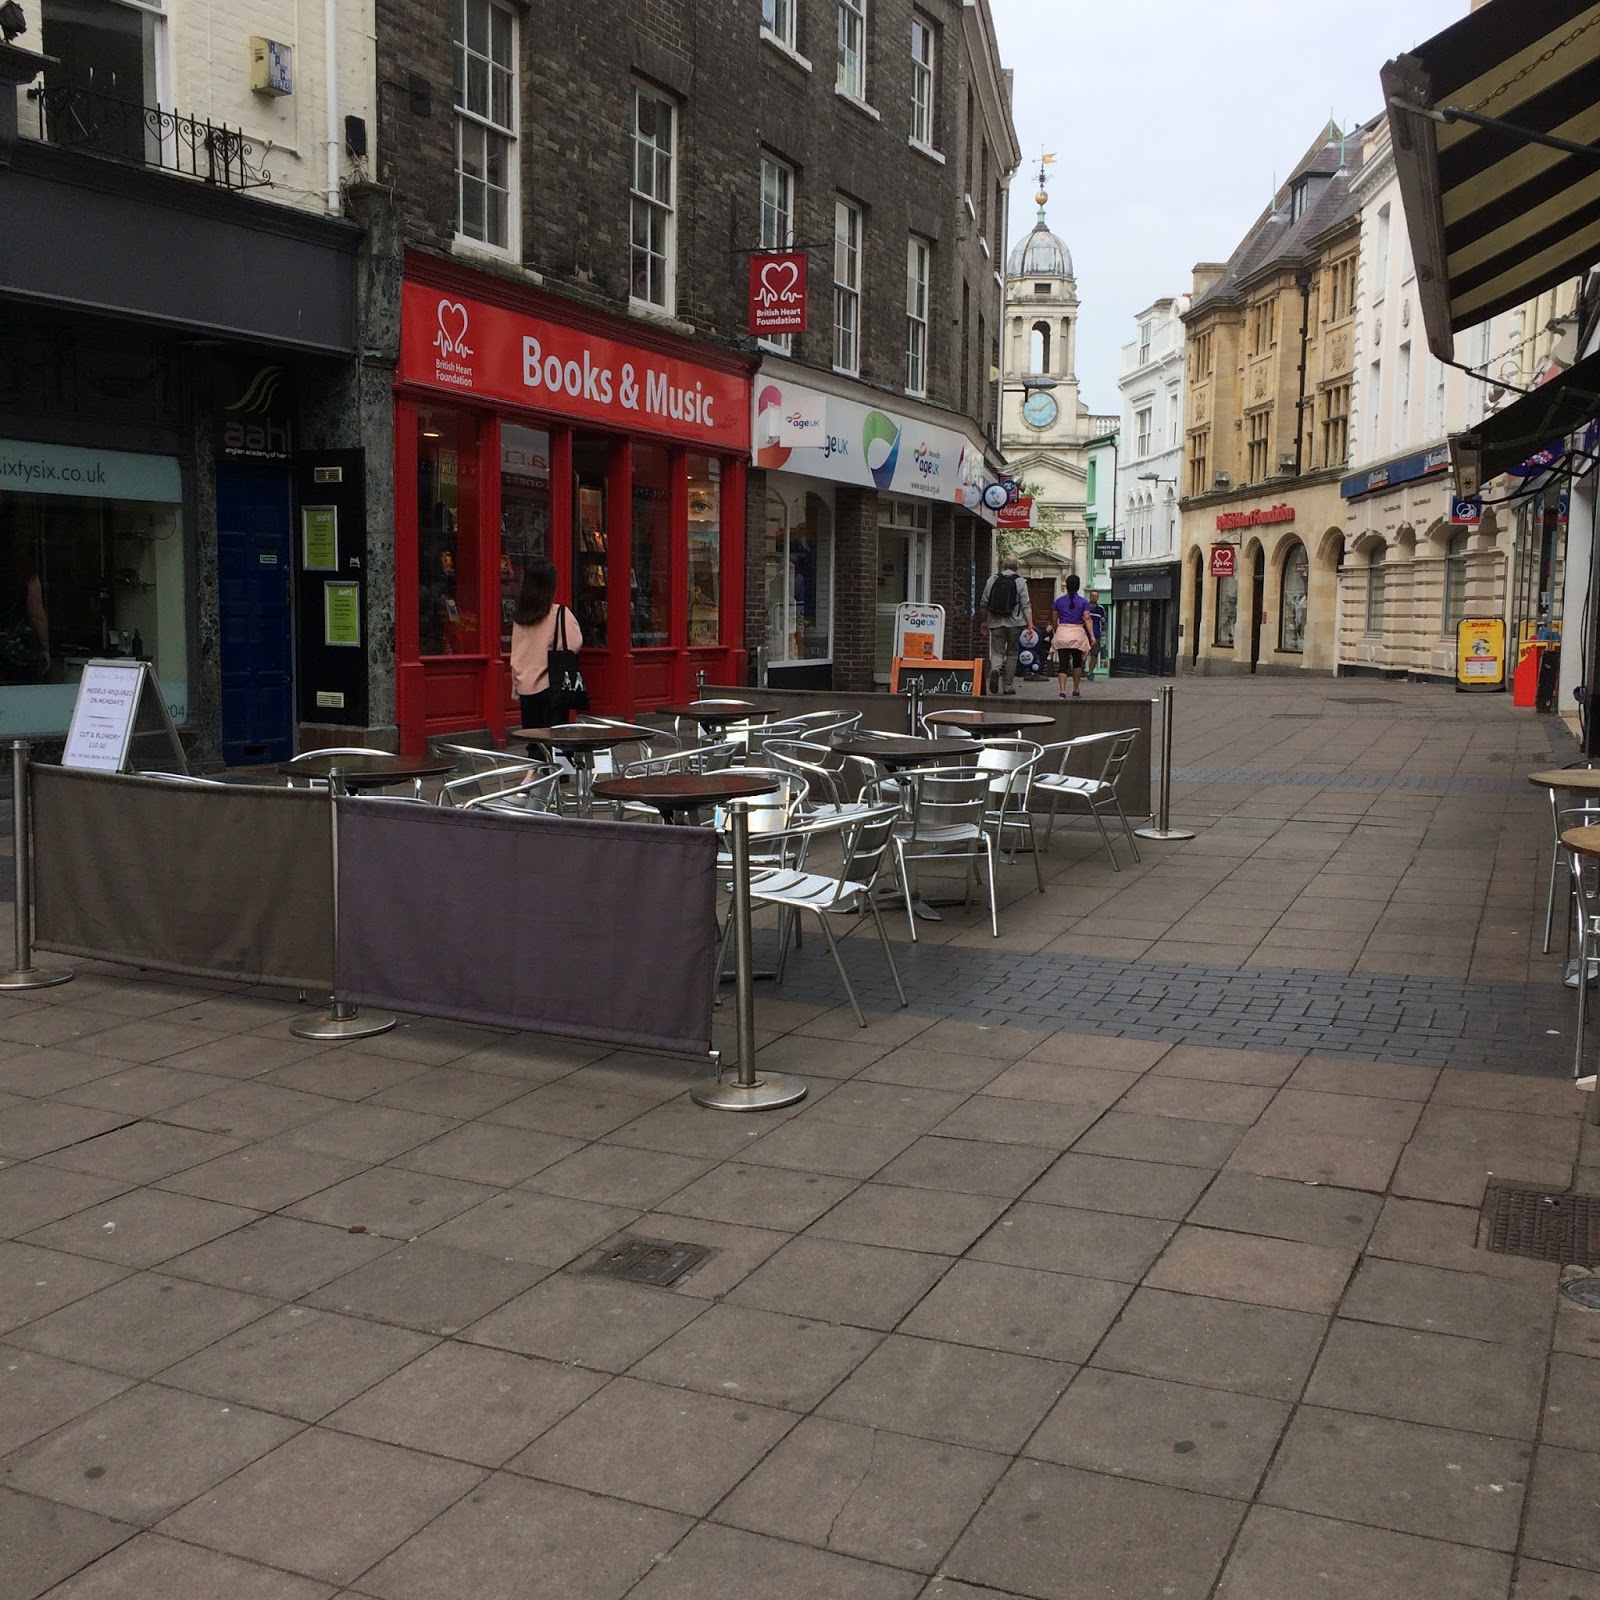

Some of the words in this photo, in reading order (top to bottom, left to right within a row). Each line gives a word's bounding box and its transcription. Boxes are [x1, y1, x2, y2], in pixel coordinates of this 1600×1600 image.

[757, 309, 779, 317] British
[780, 308, 801, 316] Heart
[756, 316, 801, 326] Foundation
[436, 358, 455, 372] British
[455, 363, 472, 376] Heart
[436, 370, 473, 387] Foundation
[522, 335, 614, 404] Books
[619, 363, 640, 411] &
[645, 369, 714, 427] Music
[792, 420, 810, 430] age
[838, 438, 849, 456] UK
[245, 449, 271, 459] academy
[918, 460, 932, 478] age
[932, 463, 940, 476] UK
[910, 618, 926, 628] age
[87, 687, 107, 695] MODELS
[107, 689, 134, 697] REQUIRED
[961, 681, 973, 692] 67
[167, 704, 185, 718] 04
